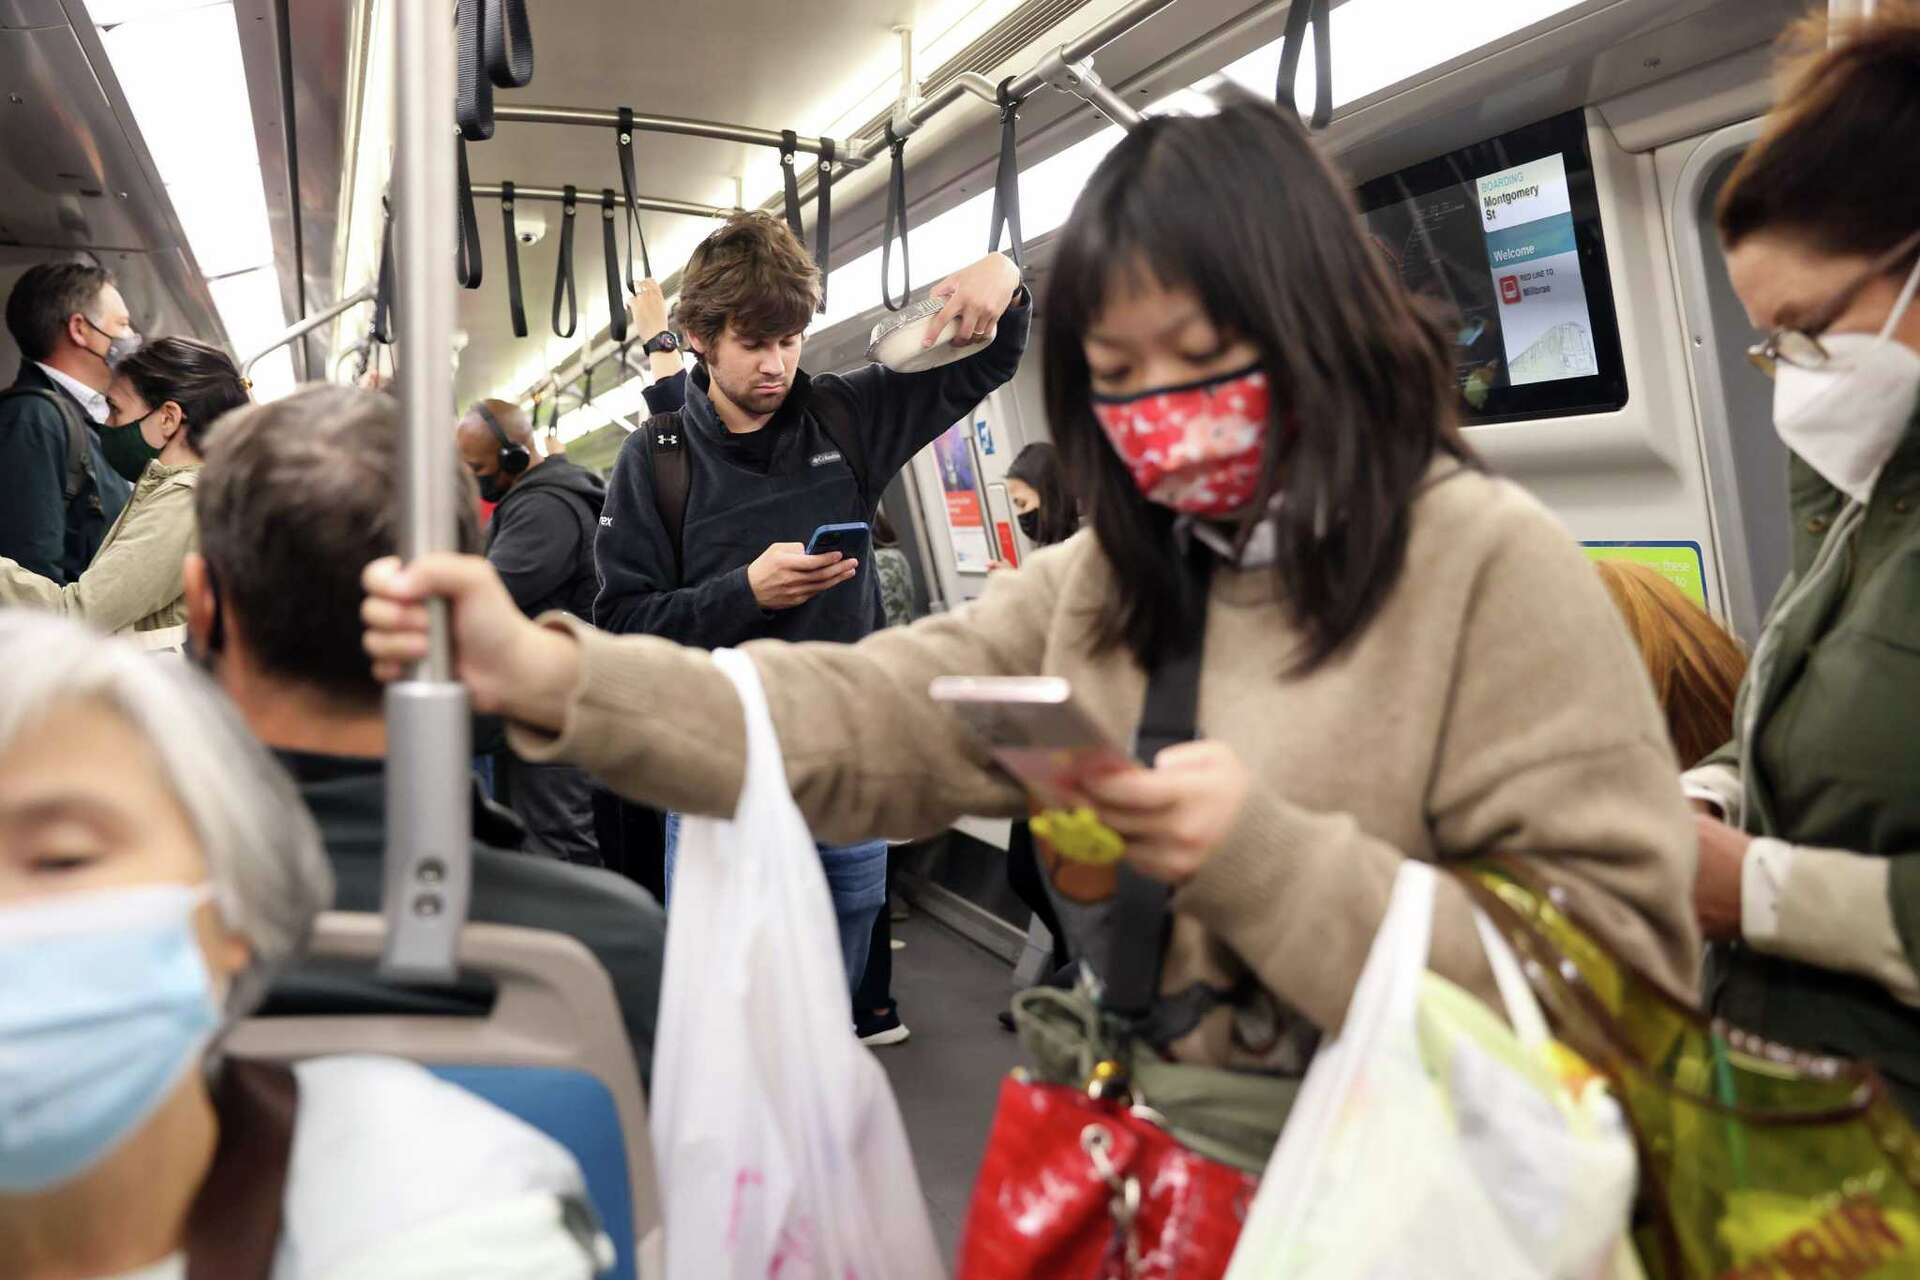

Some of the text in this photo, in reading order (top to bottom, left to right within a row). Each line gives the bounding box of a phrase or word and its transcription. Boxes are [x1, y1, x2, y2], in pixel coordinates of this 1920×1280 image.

[1481, 171, 1524, 192] BOARDING
[1483, 184, 1539, 207] Montgomery
[1485, 209, 1496, 220] St
[1493, 245, 1535, 262] Welcome
[1545, 268, 1554, 276] TO
